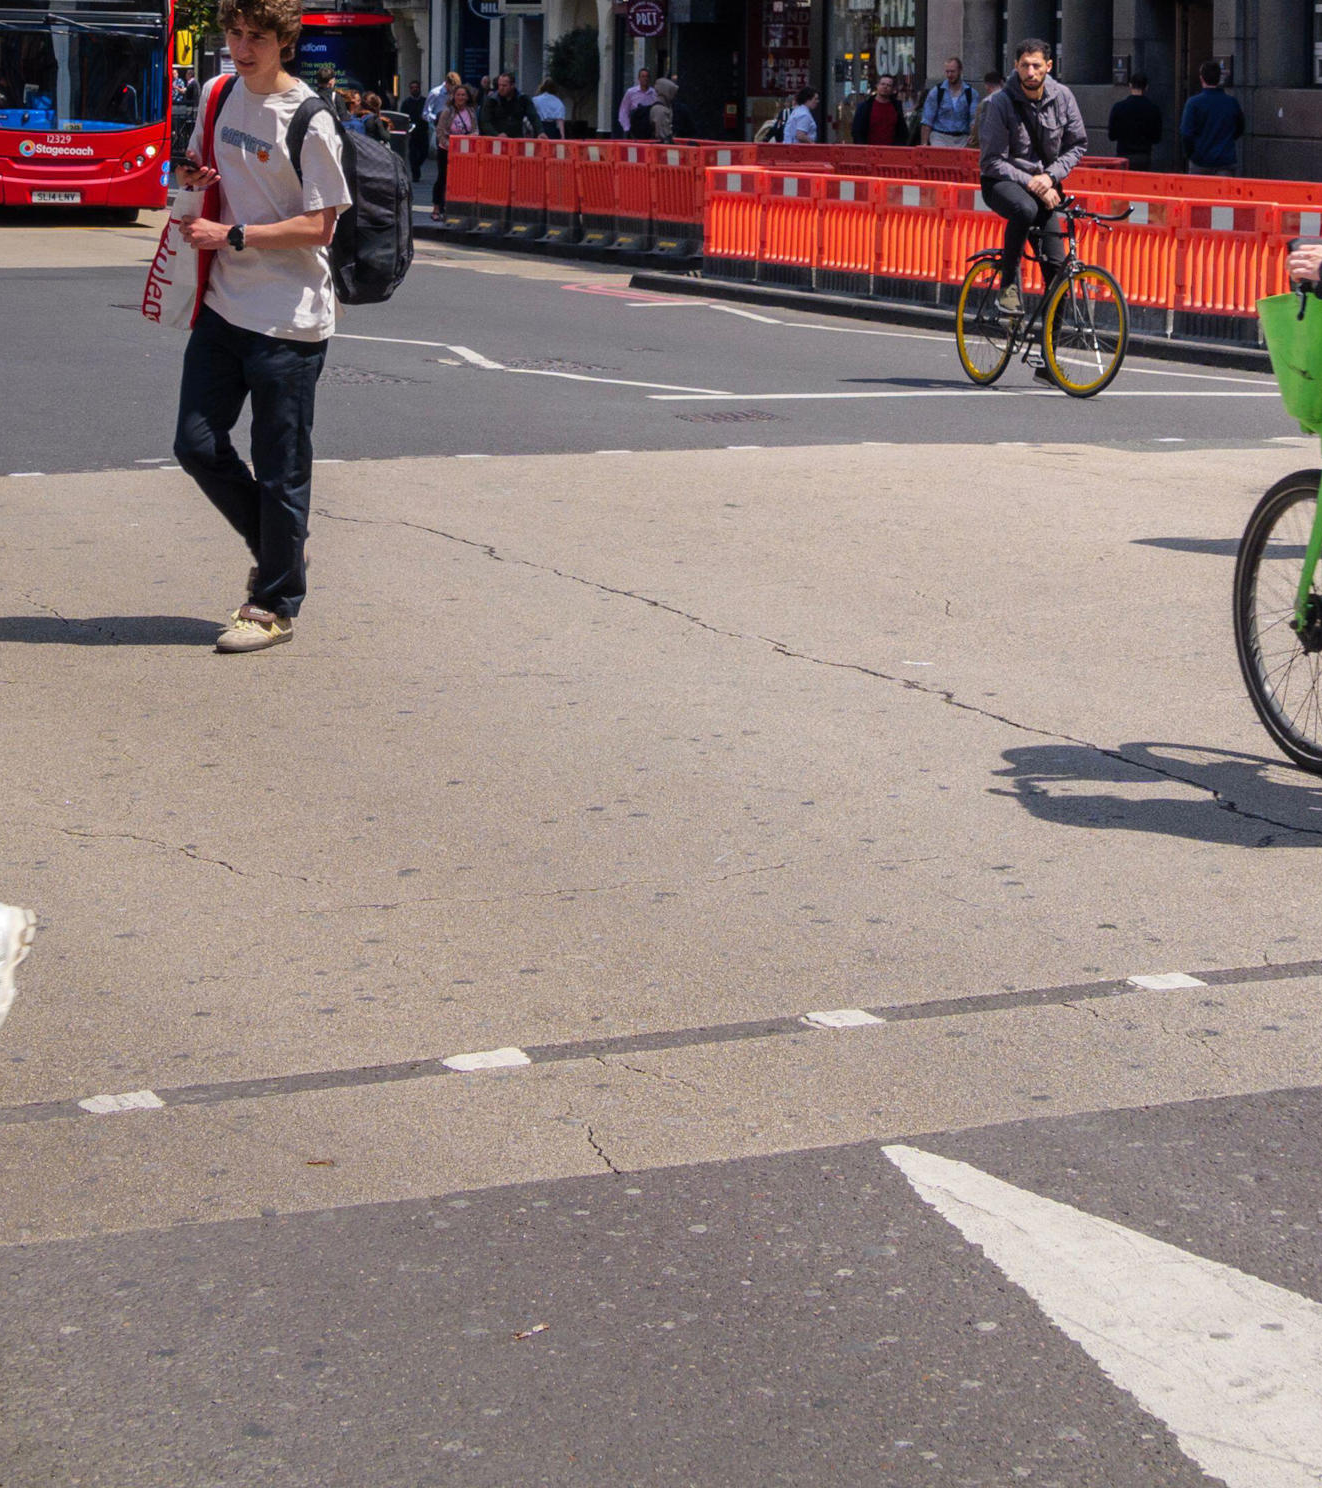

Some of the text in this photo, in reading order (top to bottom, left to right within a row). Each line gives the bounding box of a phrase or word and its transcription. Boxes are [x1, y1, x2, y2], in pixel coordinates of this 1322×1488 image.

[635, 12, 658, 26] PRET
[46, 134, 72, 144] 12329
[34, 143, 94, 158] Stagecoach
[37, 192, 56, 202] SL14
